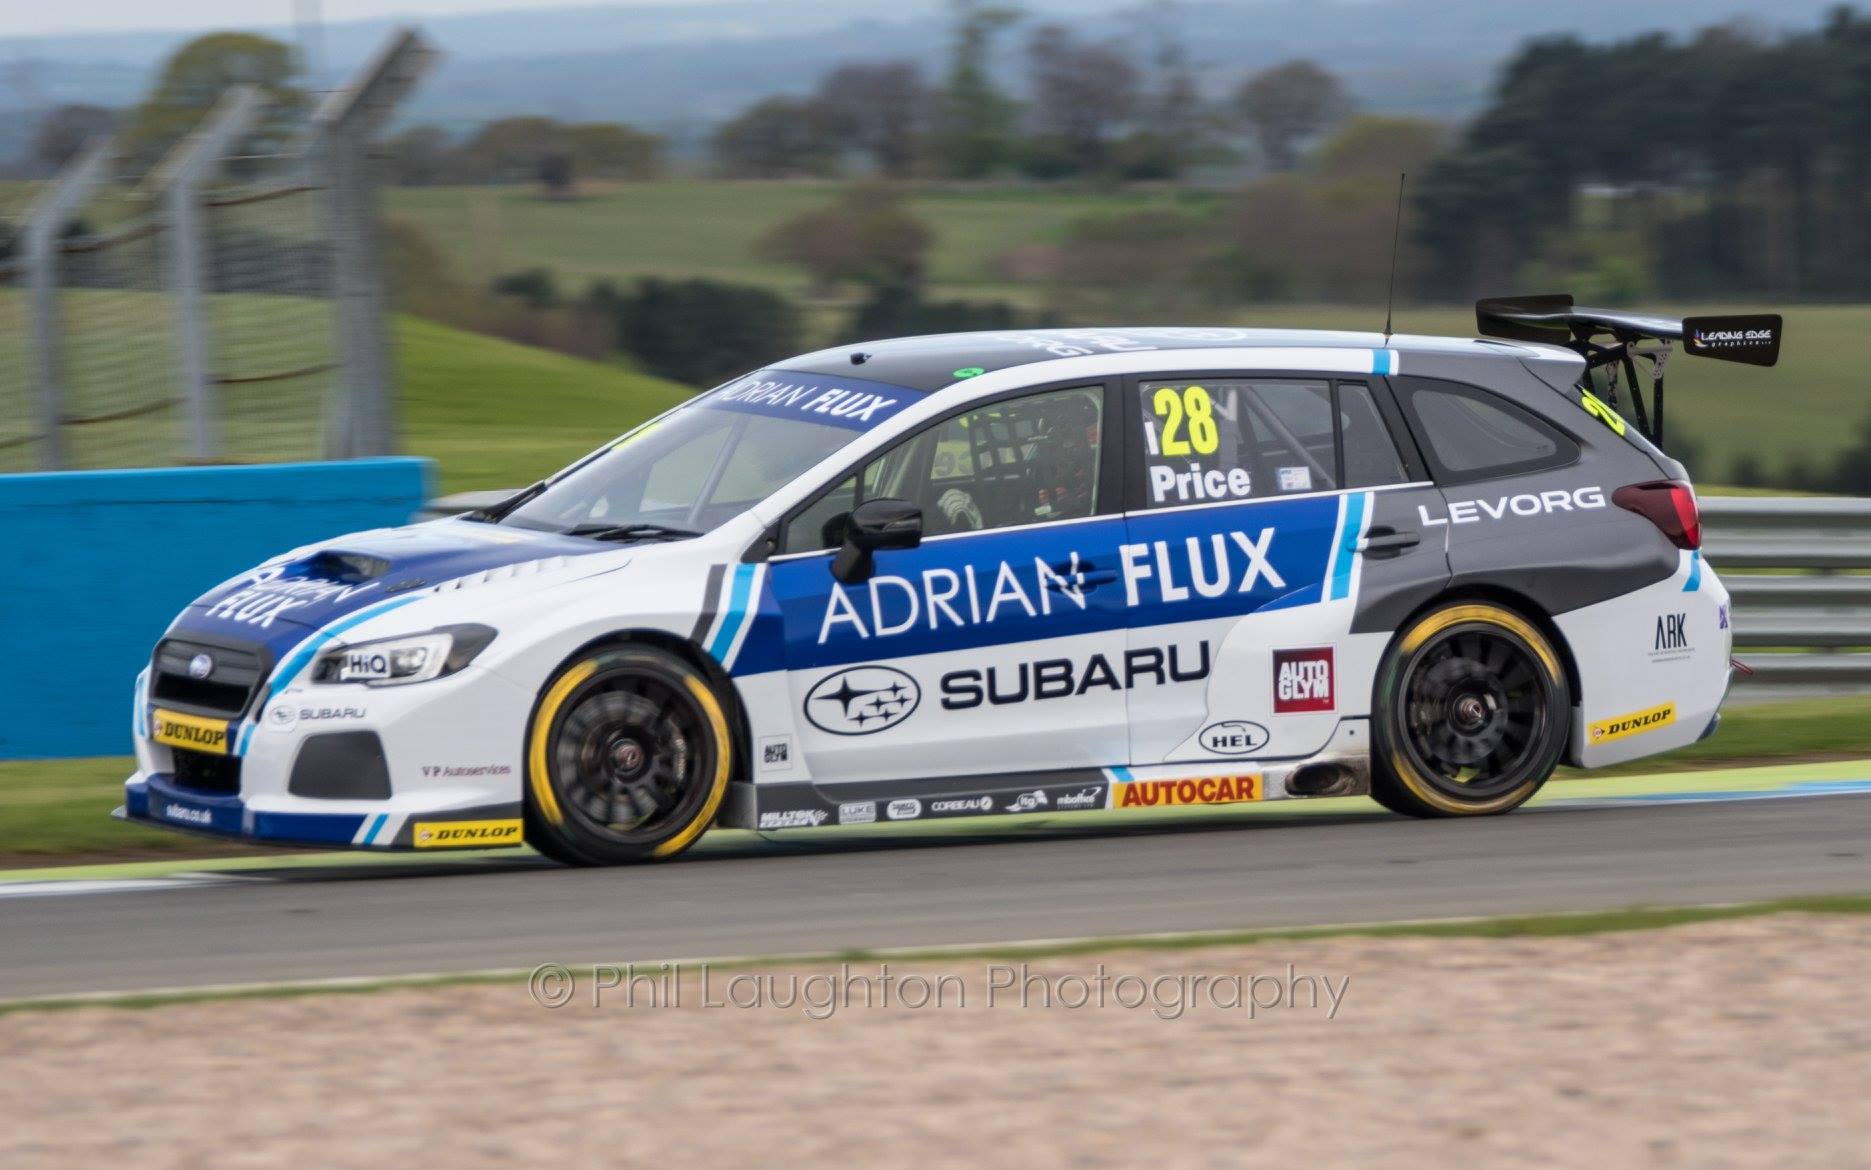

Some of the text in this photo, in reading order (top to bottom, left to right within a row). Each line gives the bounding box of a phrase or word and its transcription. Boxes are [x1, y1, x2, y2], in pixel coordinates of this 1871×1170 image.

[1701, 329, 1772, 341] LEADING EDGE
[801, 388, 898, 421] FLUX
[1580, 387, 1626, 437] 2
[1153, 386, 1219, 456] 28
[1150, 463, 1251, 503] Price
[1418, 486, 1606, 527] LEVORG
[818, 527, 1287, 645] ADRIAN FLUX
[205, 591, 308, 628] FLUX
[1655, 613, 1687, 650] ARK
[350, 655, 387, 674] HiQ
[939, 640, 1211, 711] SUBARU
[1278, 659, 1329, 682] AUTO
[1278, 677, 1329, 700] GLYM
[300, 708, 367, 720] SUBARU
[1607, 708, 1671, 736] DUNLOP
[164, 721, 224, 745] DUNLOP
[1212, 733, 1257, 748] HEL
[931, 798, 980, 812] CORBEAU
[1122, 776, 1254, 807] AUTOCAR
[436, 826, 518, 840] DUNLOP
